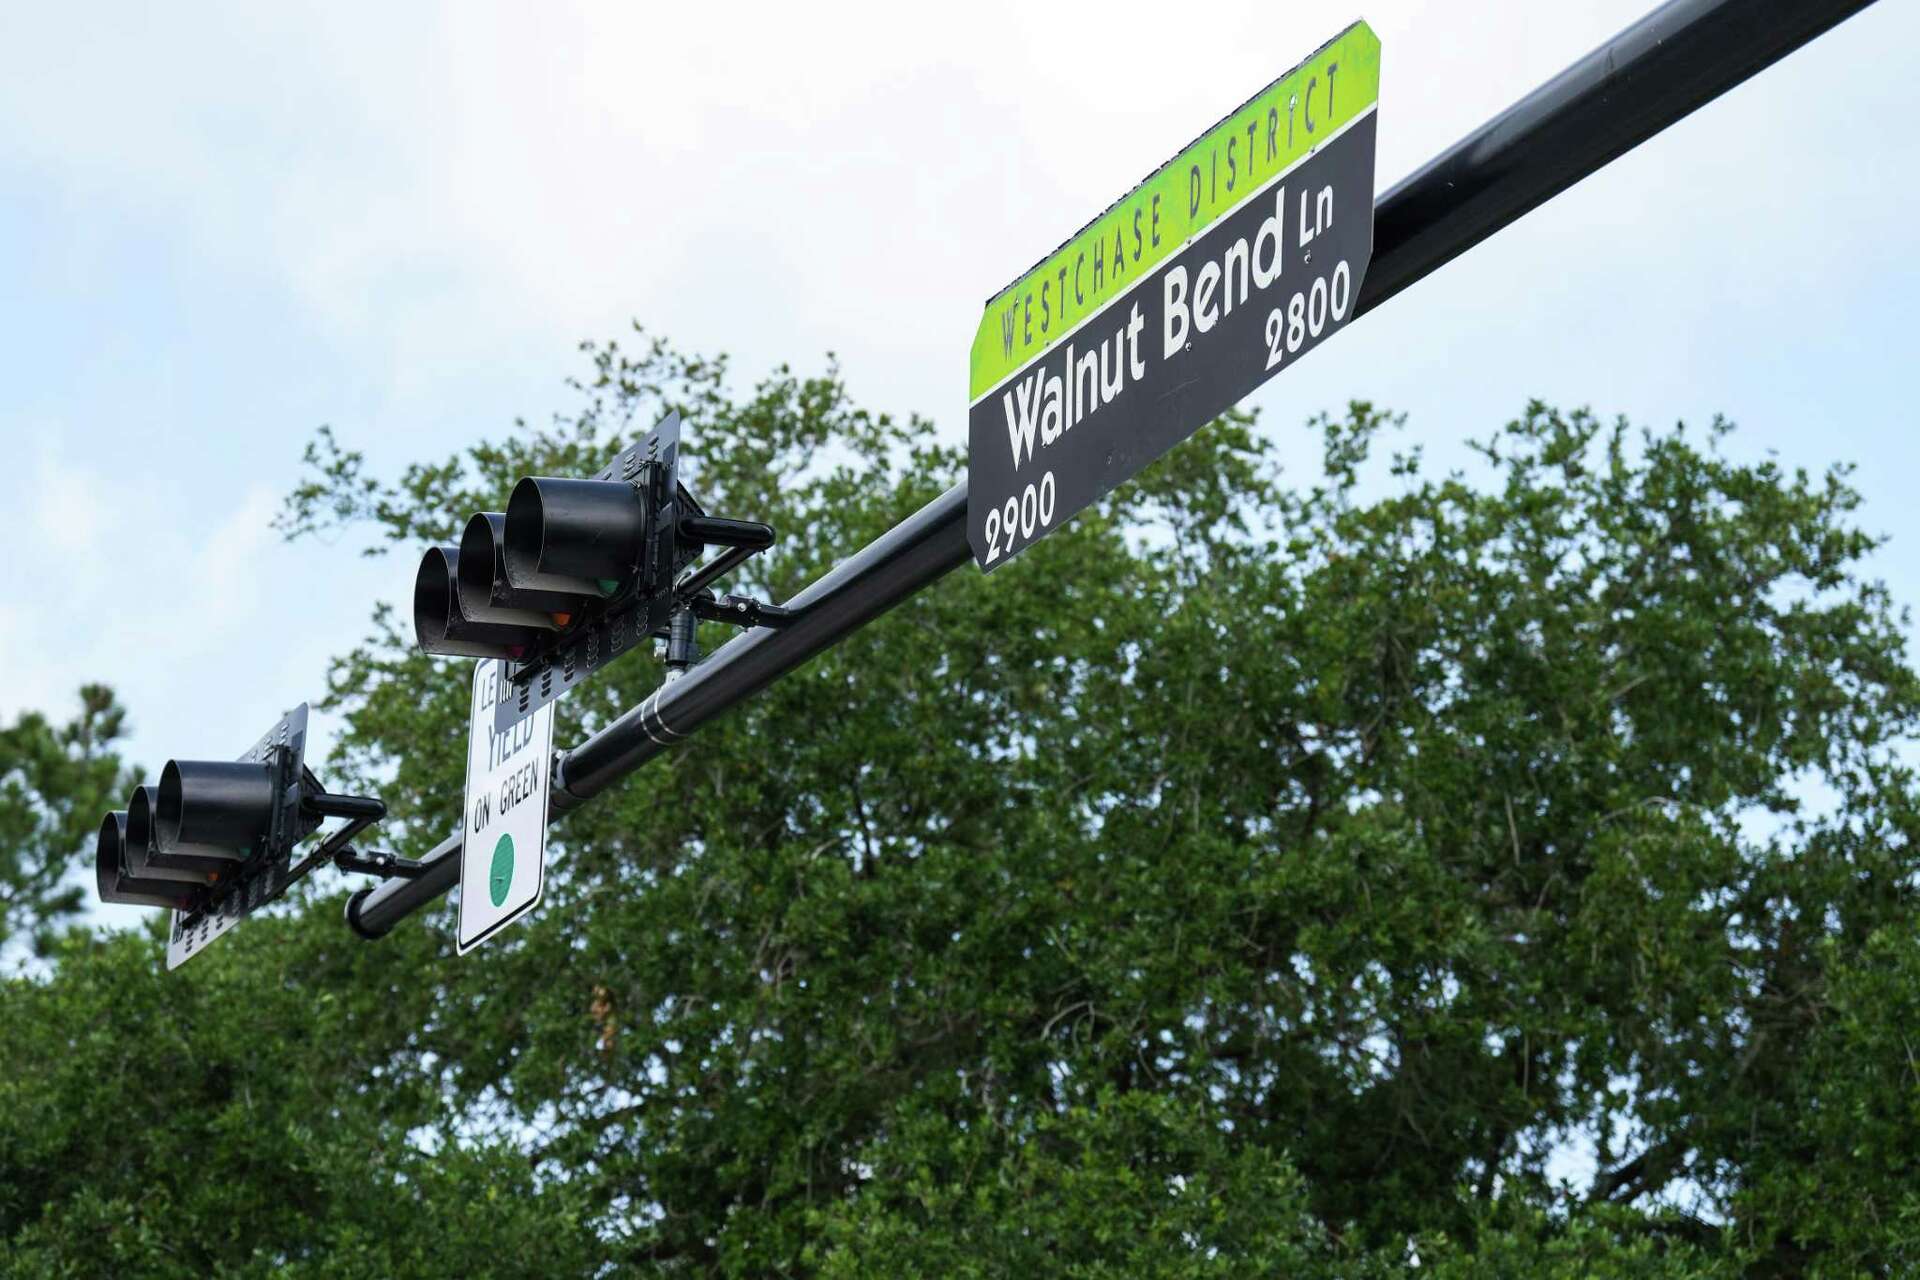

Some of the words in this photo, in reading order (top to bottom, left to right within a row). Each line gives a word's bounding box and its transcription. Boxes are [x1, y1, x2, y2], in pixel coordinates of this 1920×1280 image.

[1002, 193, 1161, 362] WESTCHASE
[1190, 63, 1338, 219] DISTRICT
[1003, 300, 1146, 472] Walnut
[1164, 186, 1285, 360] Bend
[1300, 185, 1333, 248] Ln
[1265, 260, 1350, 371] 2800
[985, 471, 1056, 565] 2900
[489, 713, 535, 772] YIELD
[475, 792, 491, 833] ON
[500, 757, 539, 816] GREEN
